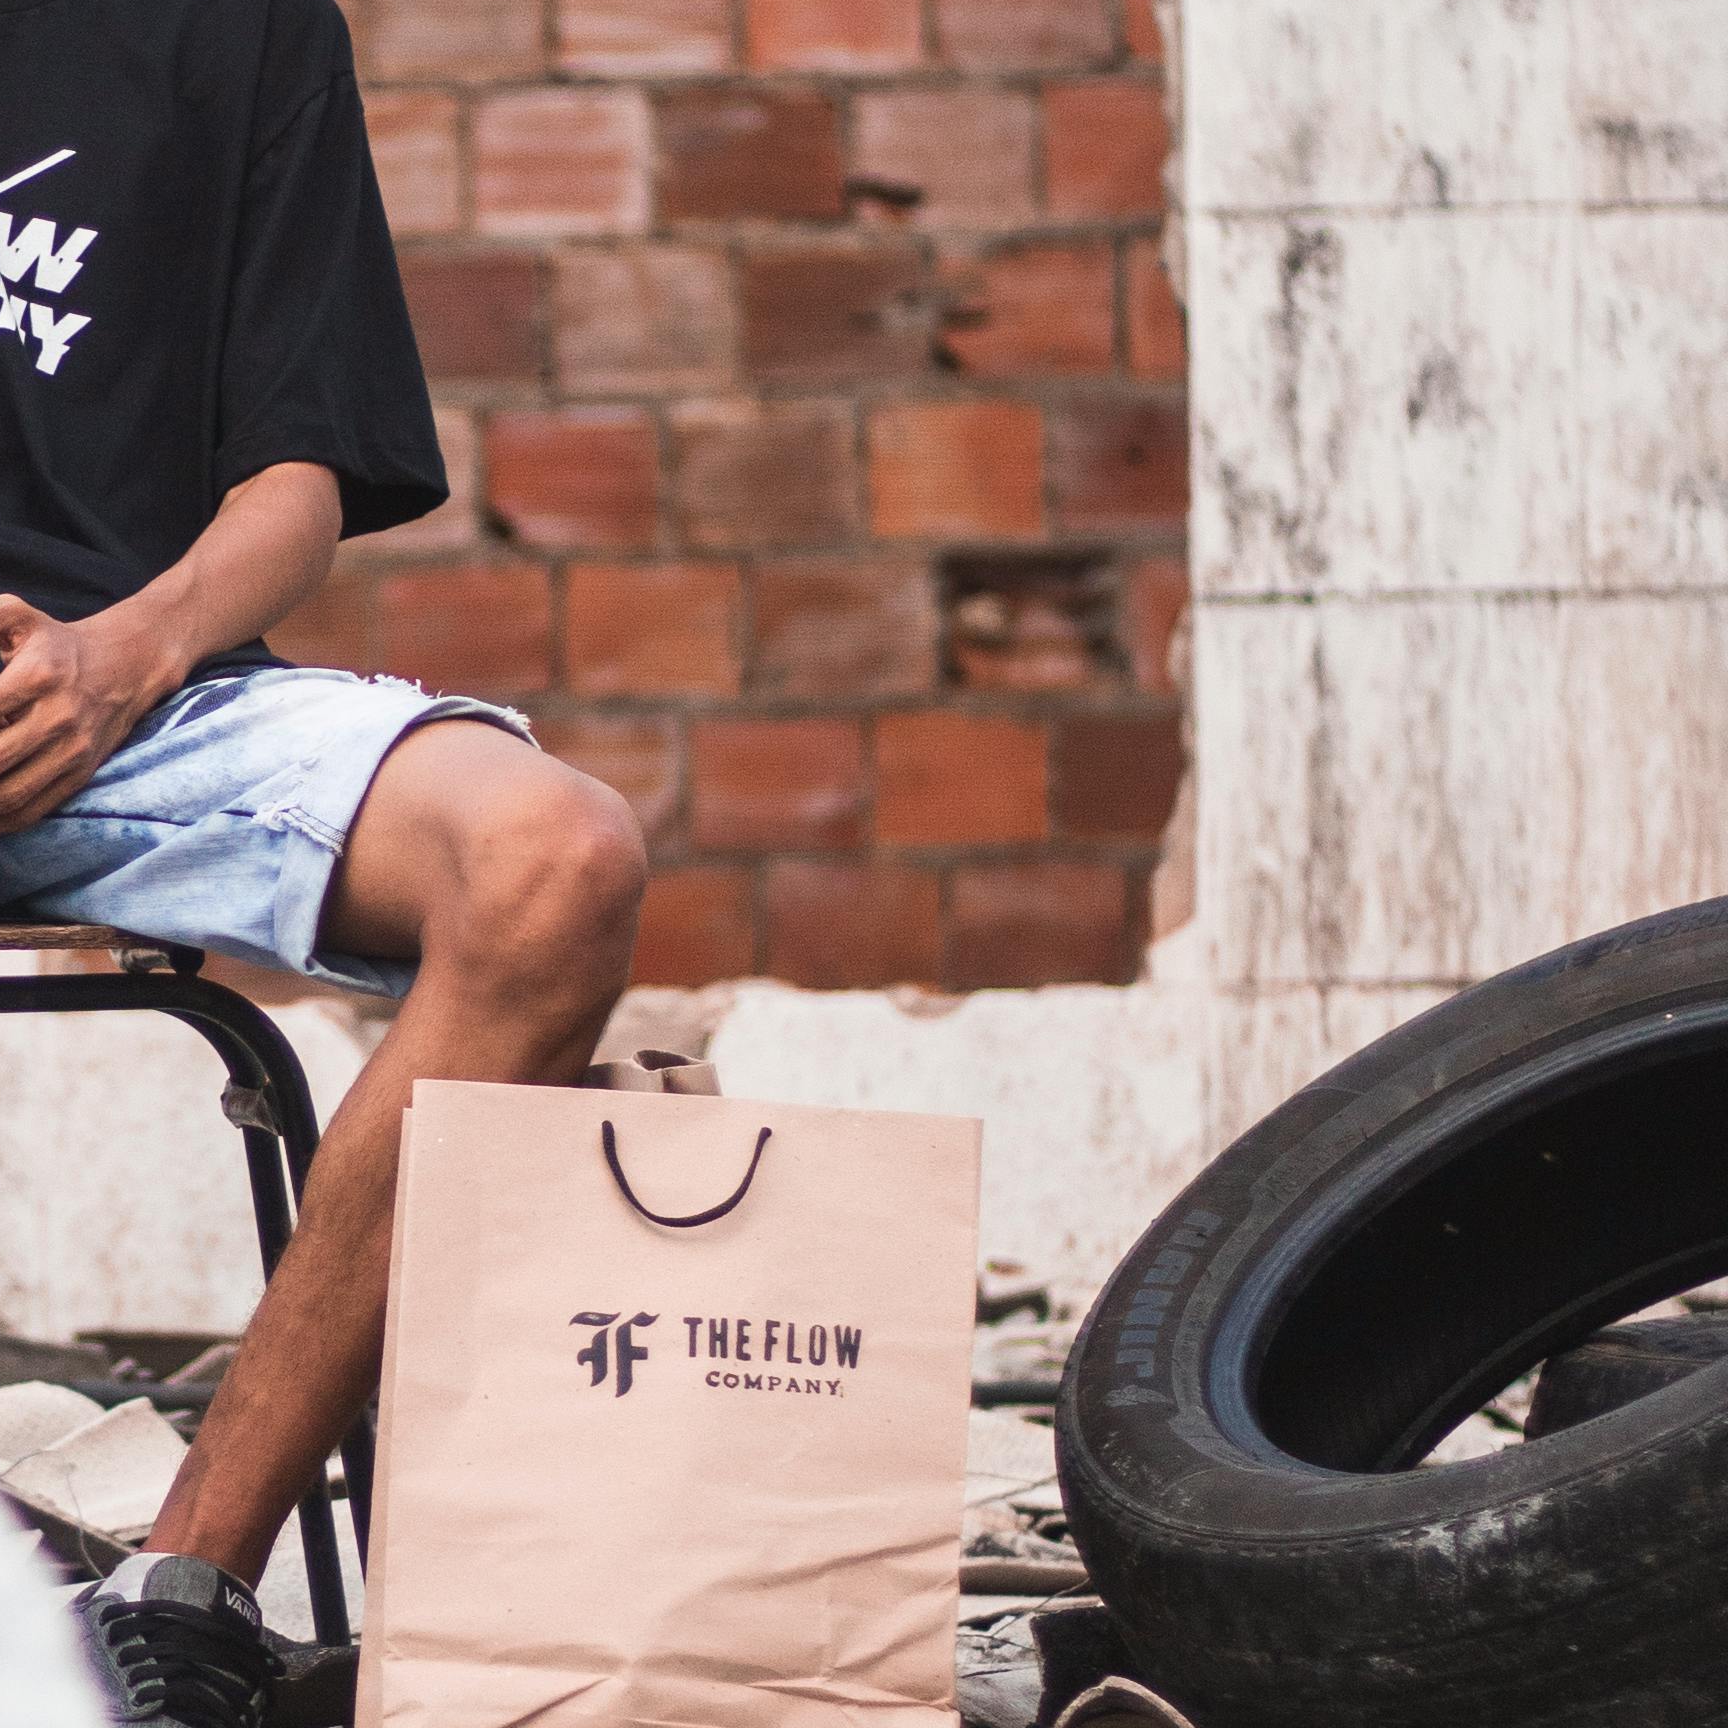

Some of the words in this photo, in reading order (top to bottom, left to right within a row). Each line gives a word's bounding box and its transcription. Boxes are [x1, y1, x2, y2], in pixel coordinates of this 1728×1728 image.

[683, 1316, 752, 1362] THE
[763, 1319, 862, 1369] FLOW
[705, 1370, 841, 1397] COMPANY
[225, 1585, 258, 1626] VANS
